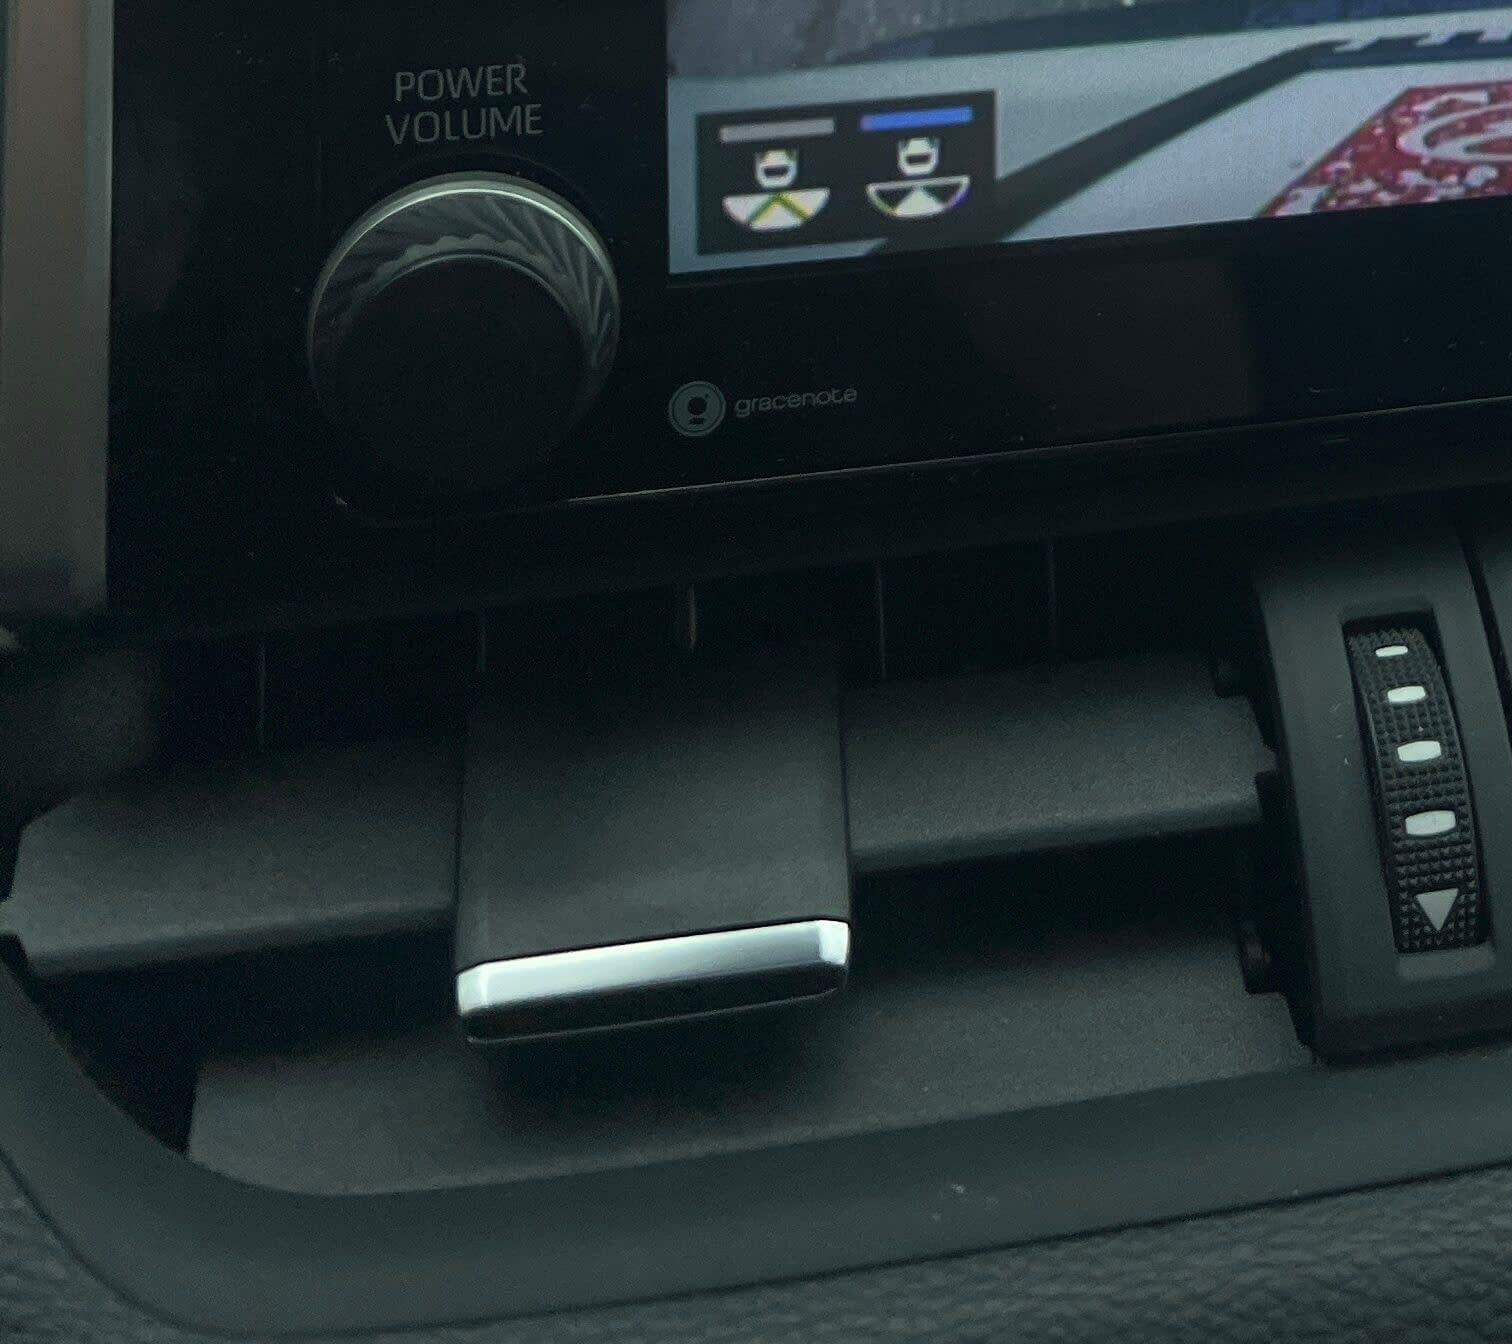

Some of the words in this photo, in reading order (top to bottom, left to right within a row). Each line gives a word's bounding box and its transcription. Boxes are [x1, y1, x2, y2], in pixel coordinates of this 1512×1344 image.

[394, 63, 529, 102] POWER
[386, 104, 543, 147] VOLUME
[734, 386, 859, 418] gracenote
